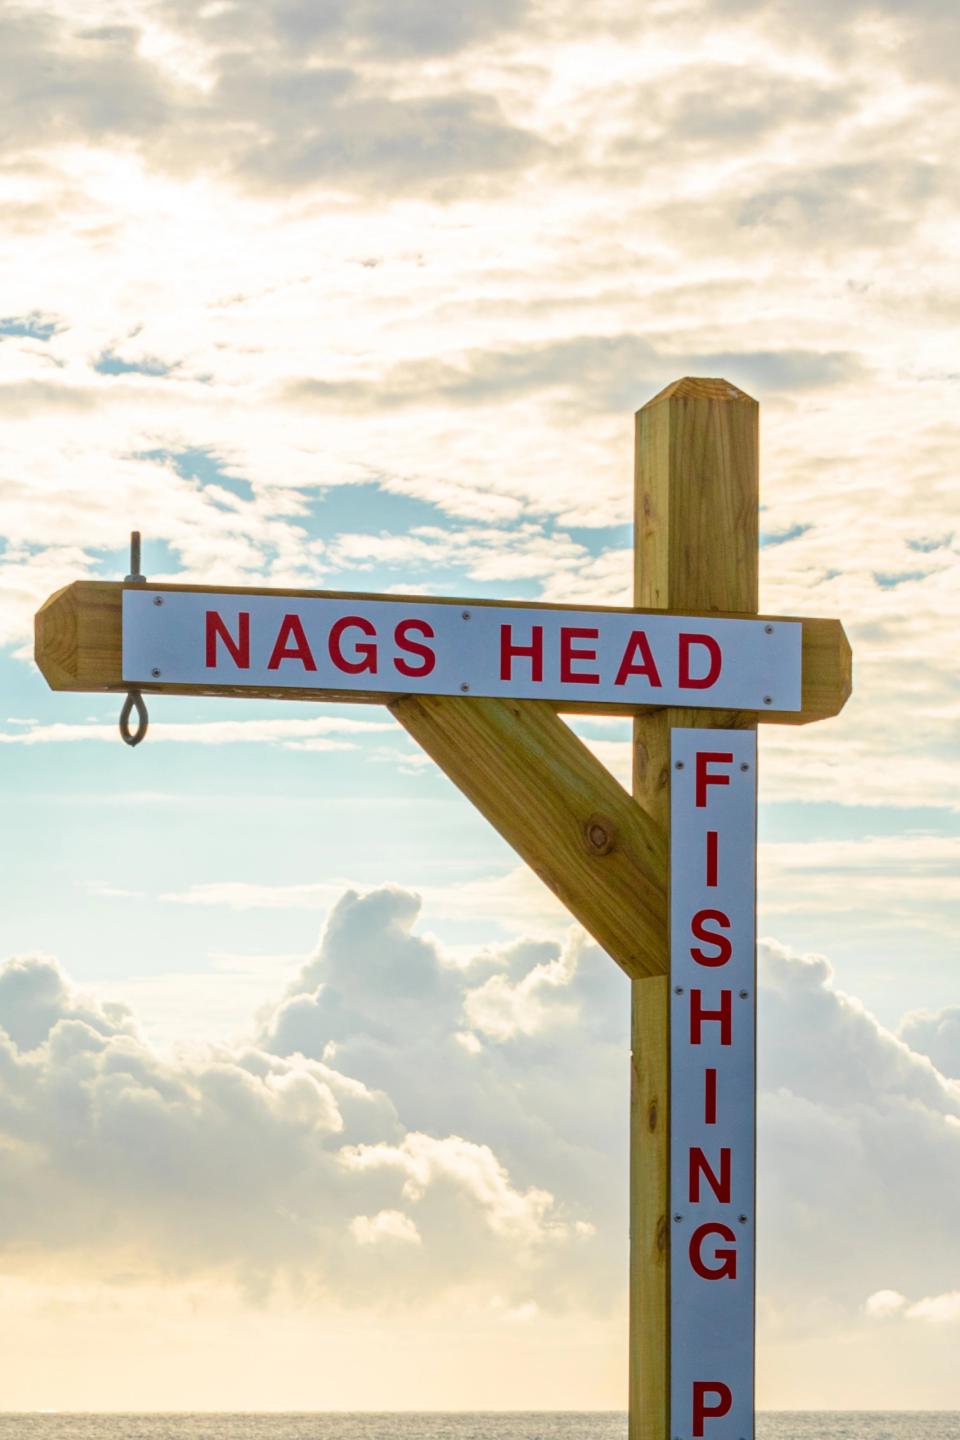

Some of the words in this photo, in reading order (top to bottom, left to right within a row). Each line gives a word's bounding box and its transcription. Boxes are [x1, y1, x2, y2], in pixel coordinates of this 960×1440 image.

[205, 610, 436, 677] NAGS
[500, 623, 722, 689] HEAD
[689, 751, 737, 1281] FISHING
